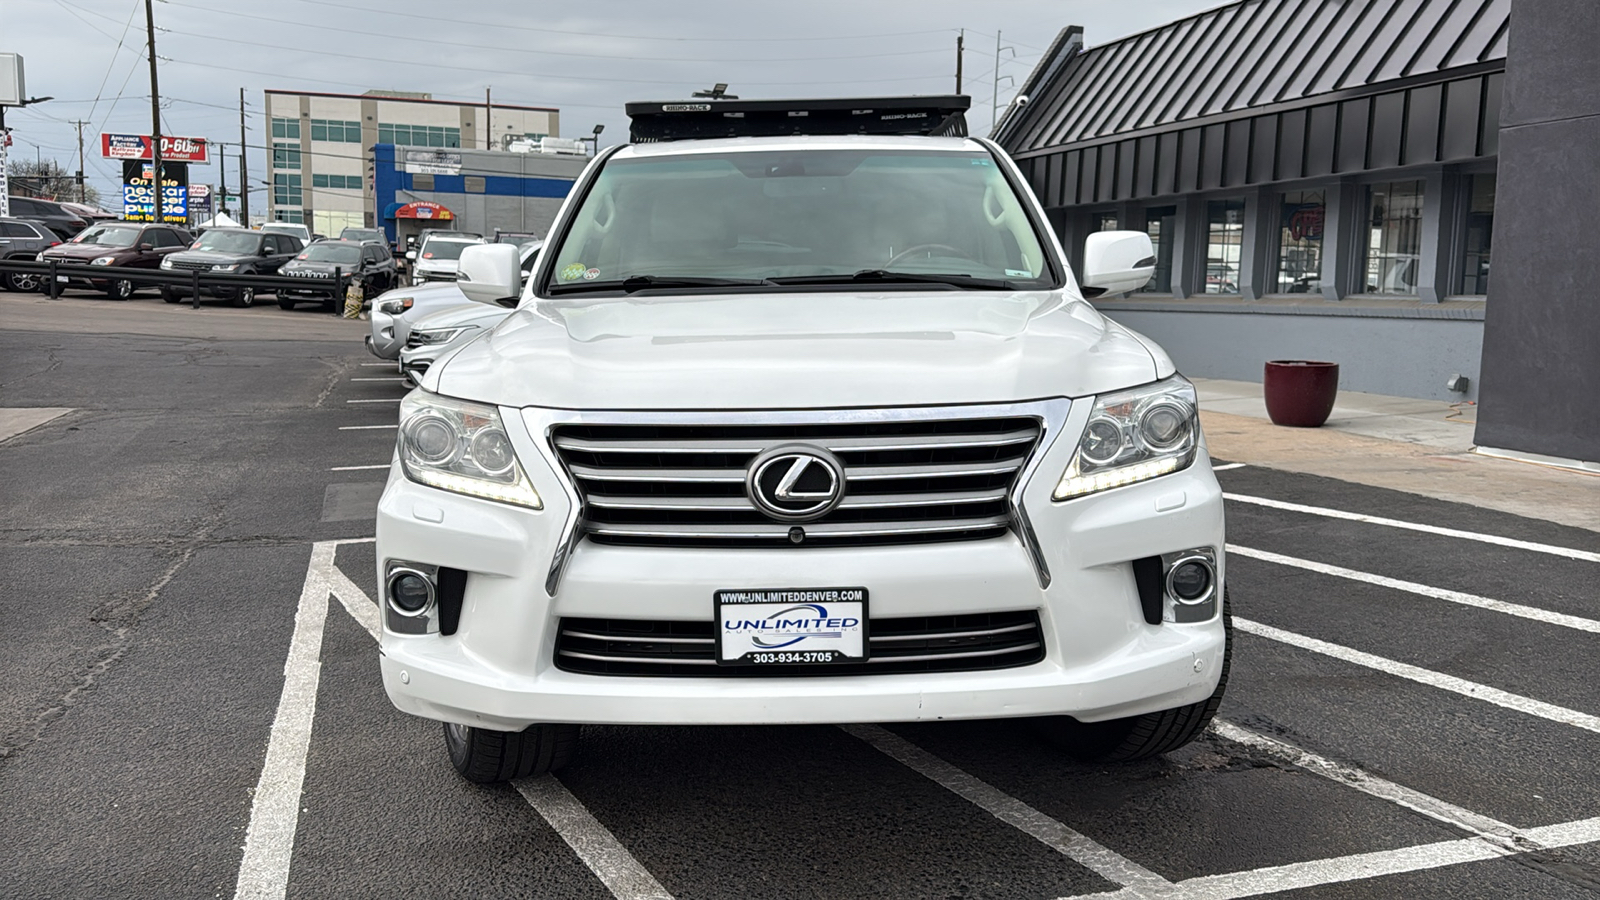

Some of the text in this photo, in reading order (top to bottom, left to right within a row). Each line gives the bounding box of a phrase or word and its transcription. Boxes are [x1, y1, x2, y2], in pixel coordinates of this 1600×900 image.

[130, 177, 149, 186] On
[409, 201, 440, 210] ENTRANCE
[163, 215, 187, 223] elivery
[720, 591, 863, 603] WWW.UNLIMITEDDENVER.COM
[724, 618, 859, 629] UNLIMITED
[753, 652, 832, 664] 303-934-3705
